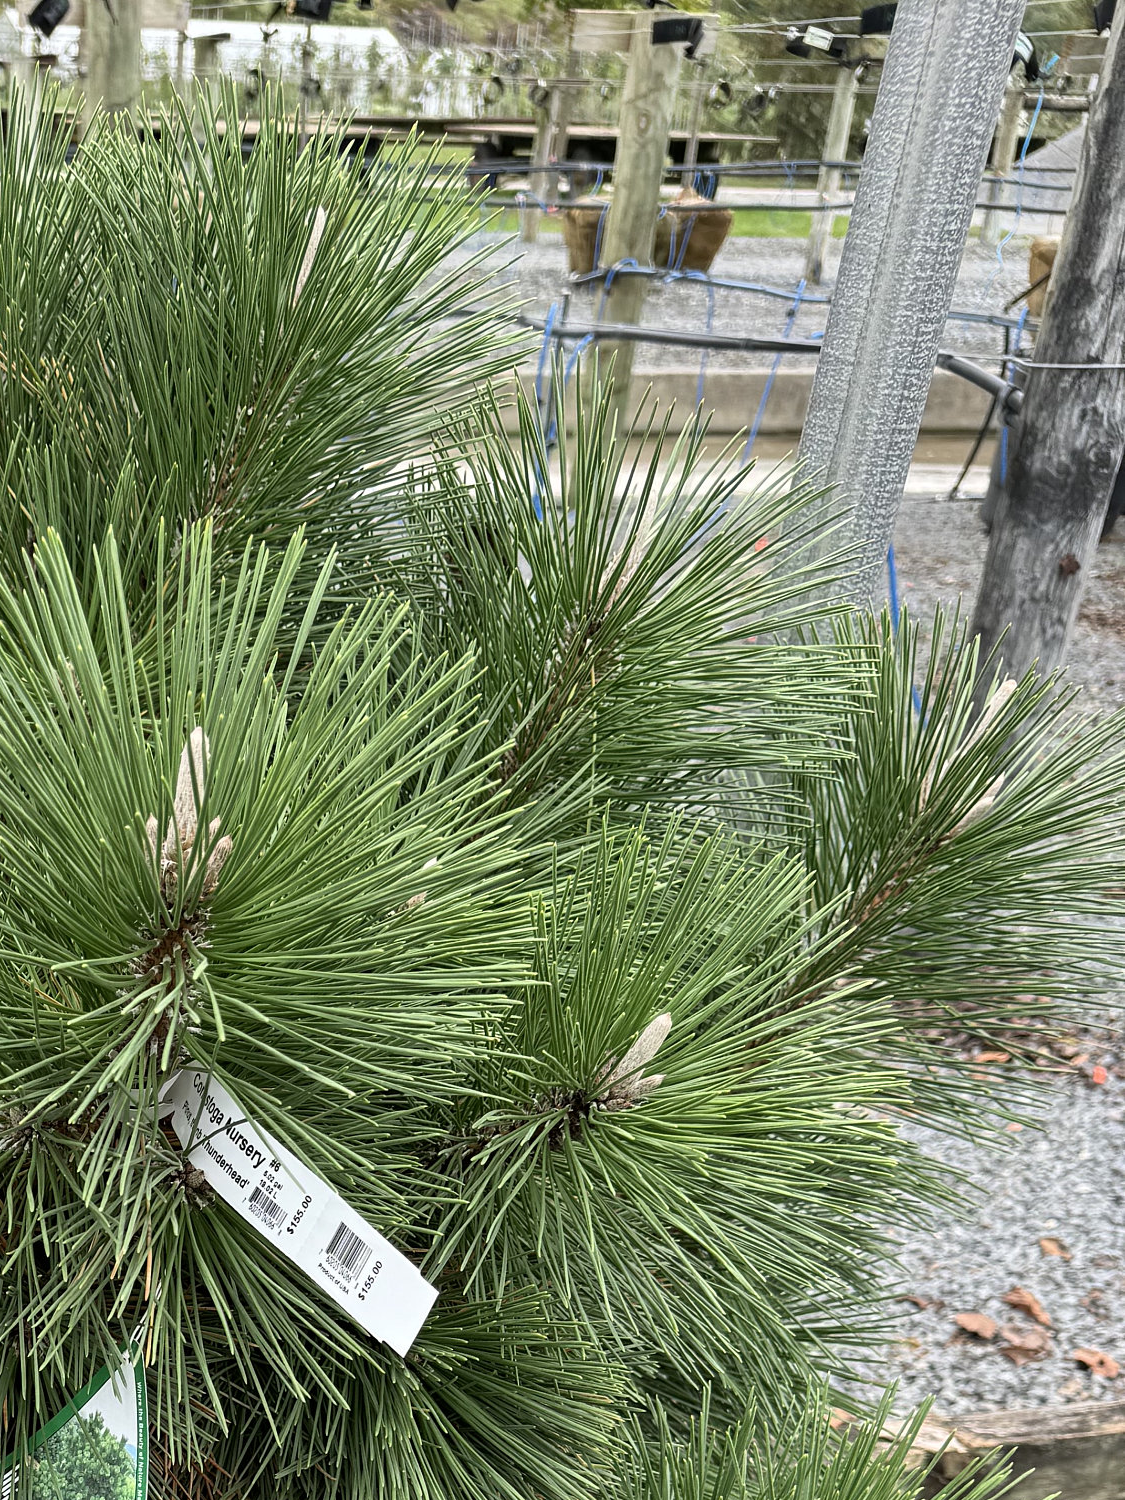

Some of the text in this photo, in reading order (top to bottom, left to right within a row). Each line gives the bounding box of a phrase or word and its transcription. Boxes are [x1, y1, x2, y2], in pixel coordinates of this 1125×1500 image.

[193, 1073, 266, 1169] Costoga Nursery
[268, 1159, 281, 1172] #6
[273, 1191, 278, 1199] L
[286, 1195, 313, 1235] $155.00
[318, 1262, 335, 1281] Product
[339, 1283, 350, 1294] USA
[357, 1260, 383, 1301] $155.00
[138, 1452, 143, 1460] of
